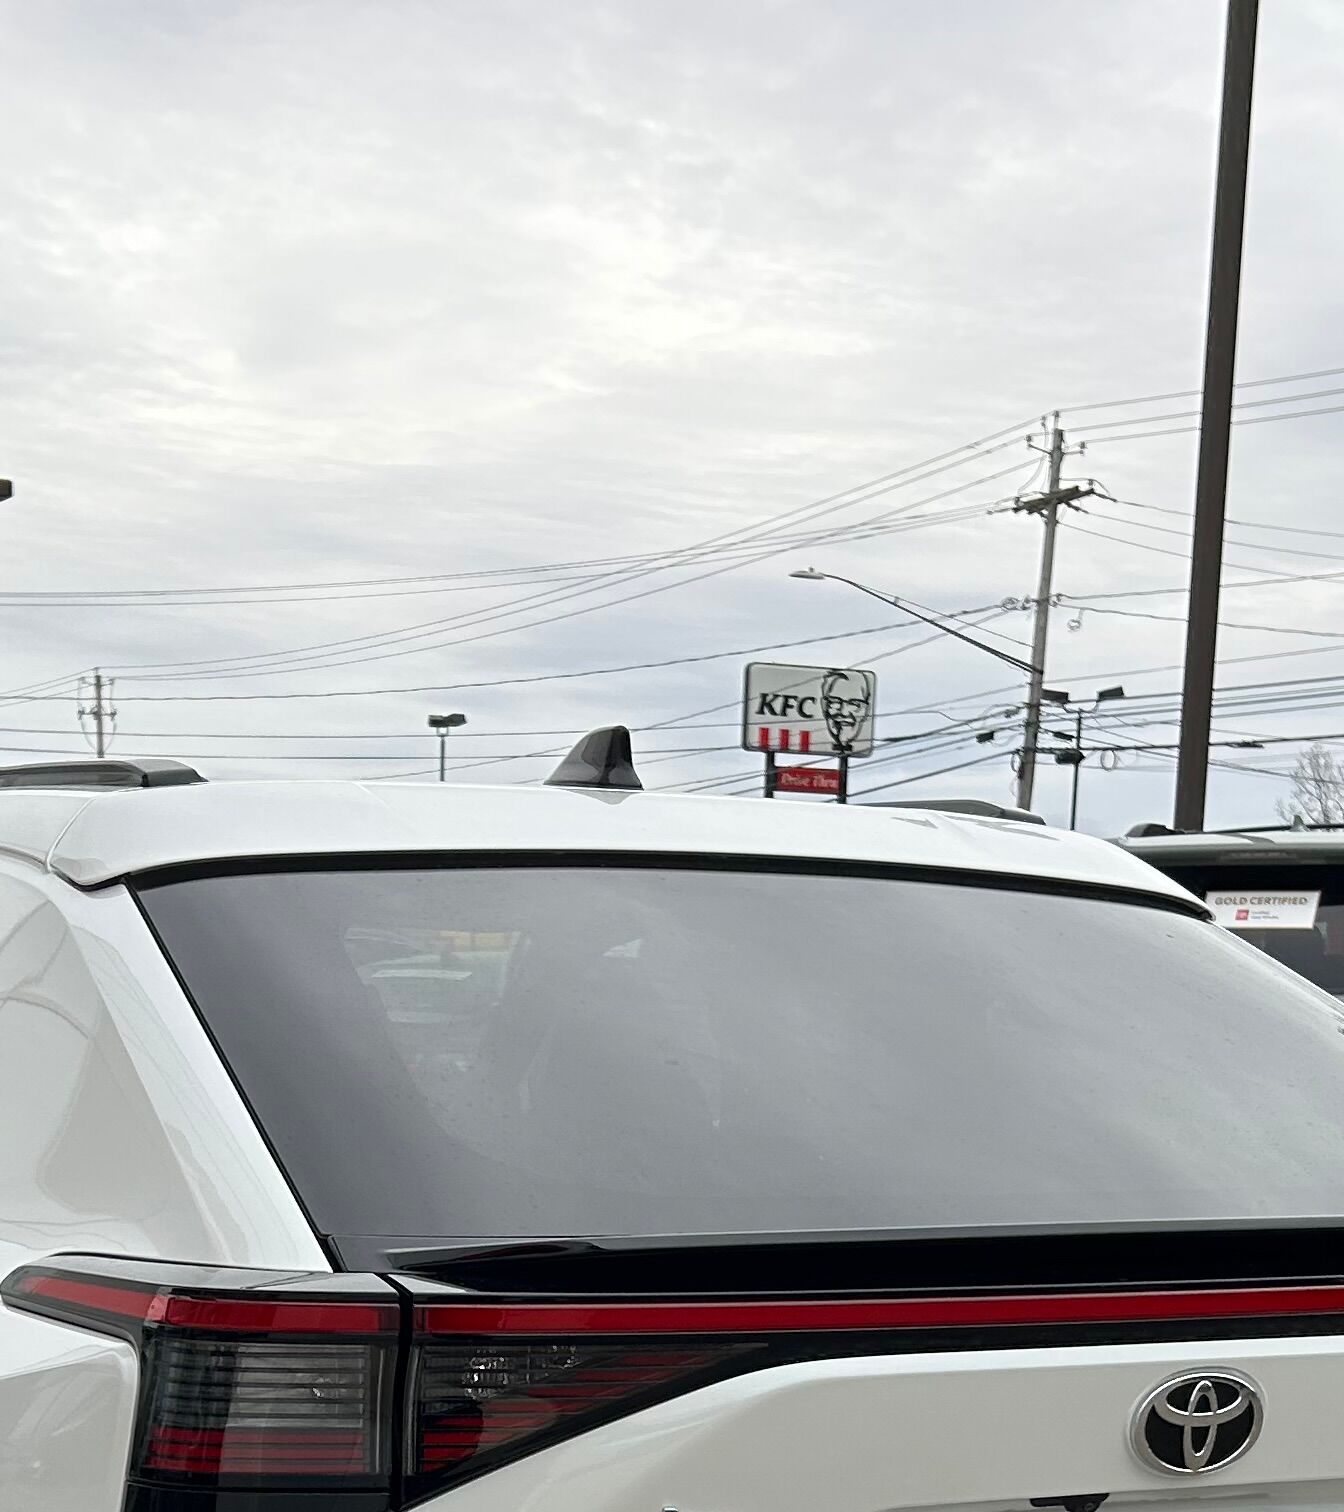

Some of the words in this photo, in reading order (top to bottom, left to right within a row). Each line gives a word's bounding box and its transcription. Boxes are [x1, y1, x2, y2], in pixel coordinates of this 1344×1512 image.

[756, 693, 816, 719] KFC
[1214, 896, 1248, 906] GOLD
[1249, 896, 1308, 906] CERTIFIED
